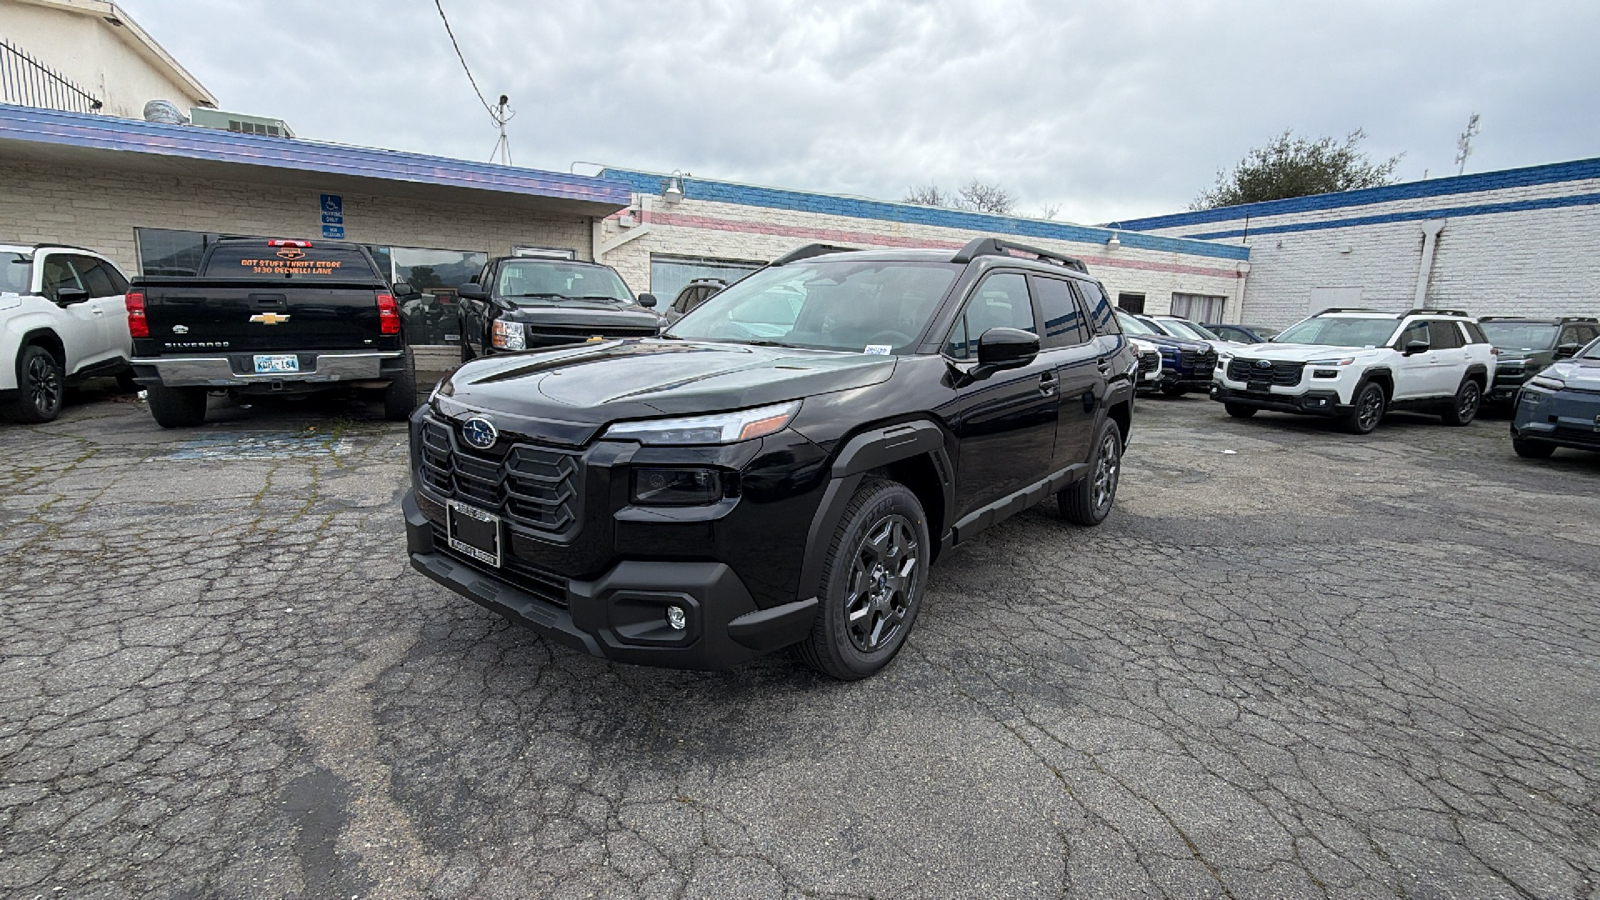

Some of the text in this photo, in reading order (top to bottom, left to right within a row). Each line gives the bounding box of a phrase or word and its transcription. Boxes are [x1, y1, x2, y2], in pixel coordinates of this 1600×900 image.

[285, 260, 315, 268] THRIFT
[253, 266, 272, 274] 3130
[312, 267, 333, 275] LANE
